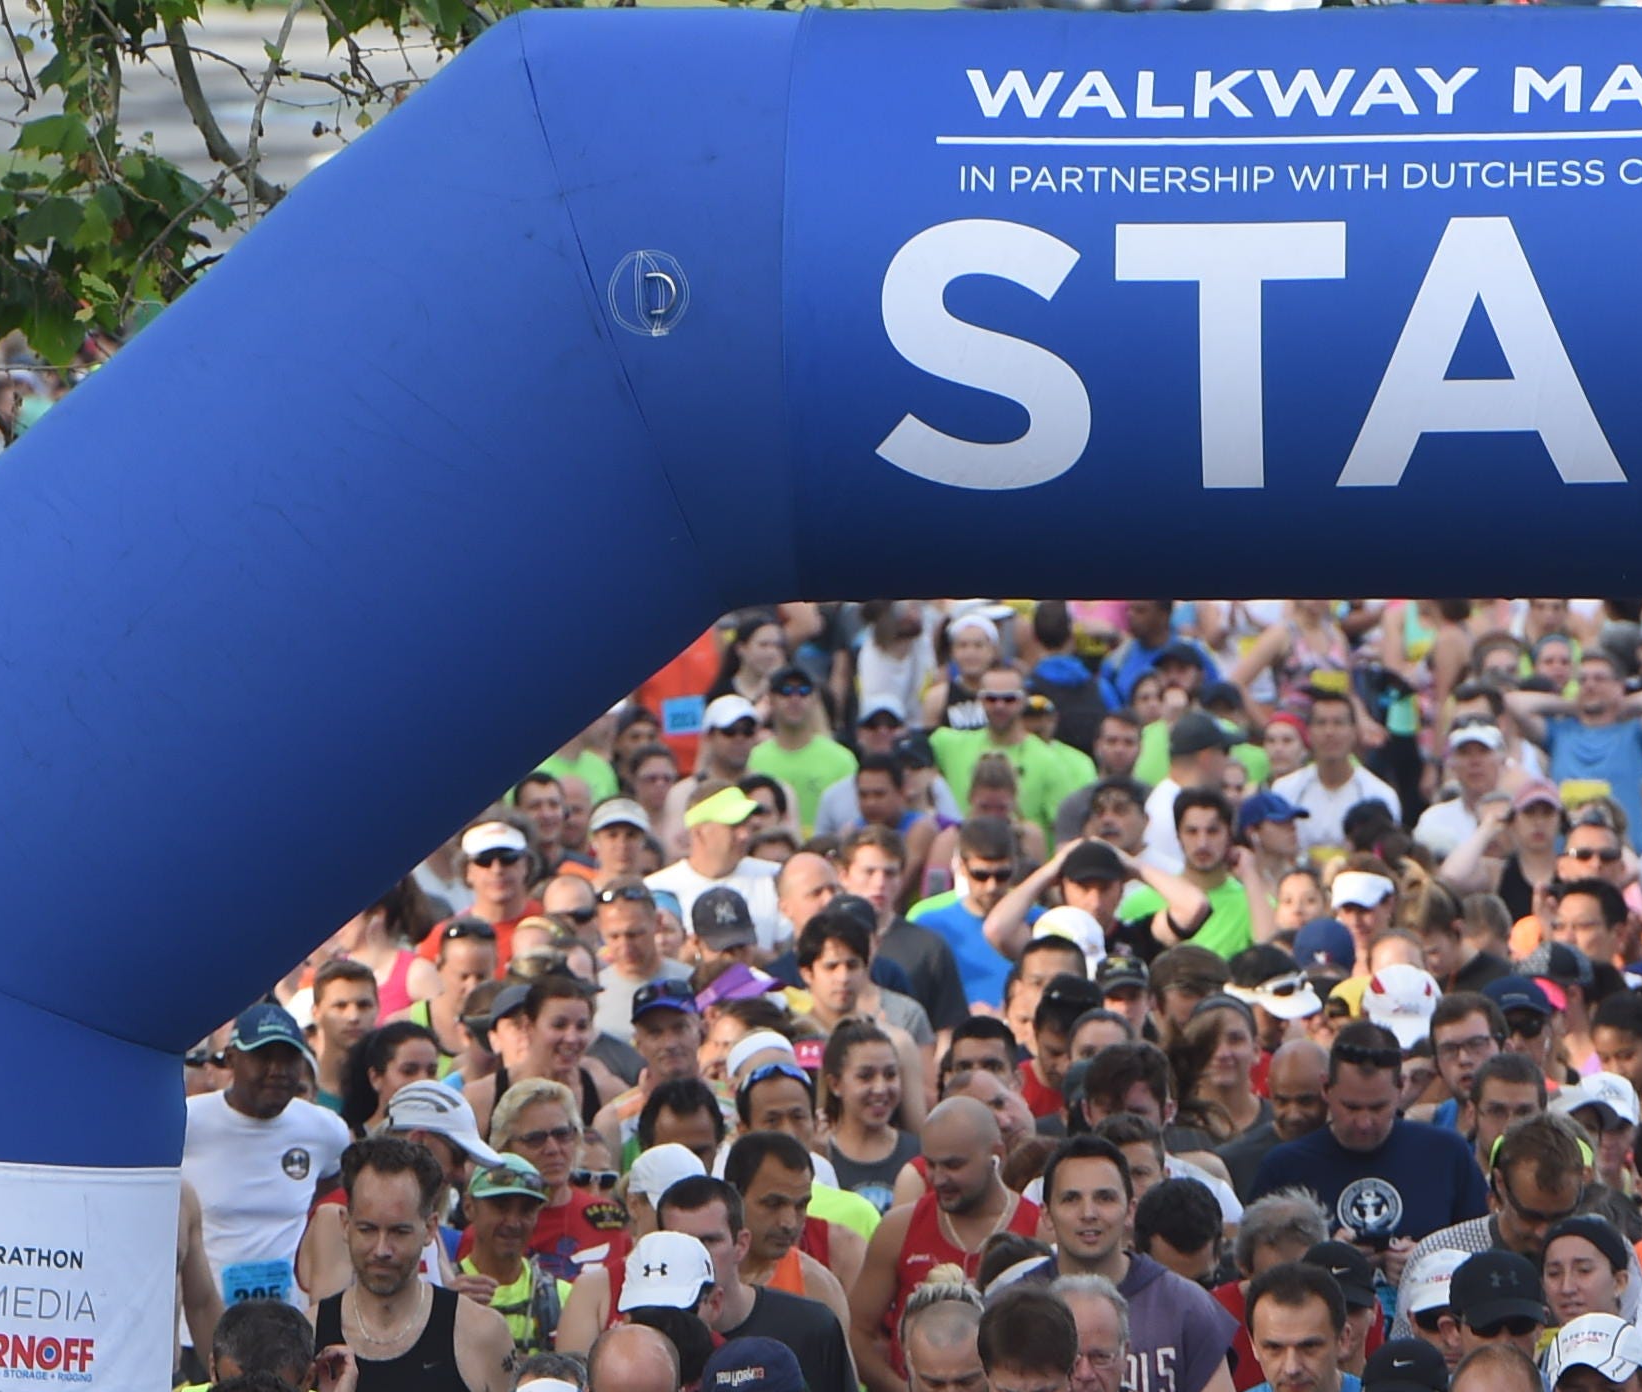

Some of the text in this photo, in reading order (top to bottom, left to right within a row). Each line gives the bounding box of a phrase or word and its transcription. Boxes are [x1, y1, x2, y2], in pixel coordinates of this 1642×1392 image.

[965, 68, 1479, 122] WALKWAY
[959, 165, 997, 194] IN
[1008, 160, 1276, 195] PARTNERSHIP
[1288, 158, 1390, 191] WITH
[1401, 156, 1607, 190] DUTCHESS
[3, 1369, 48, 1382] STORAGE
[57, 1372, 93, 1384] RIGGING
